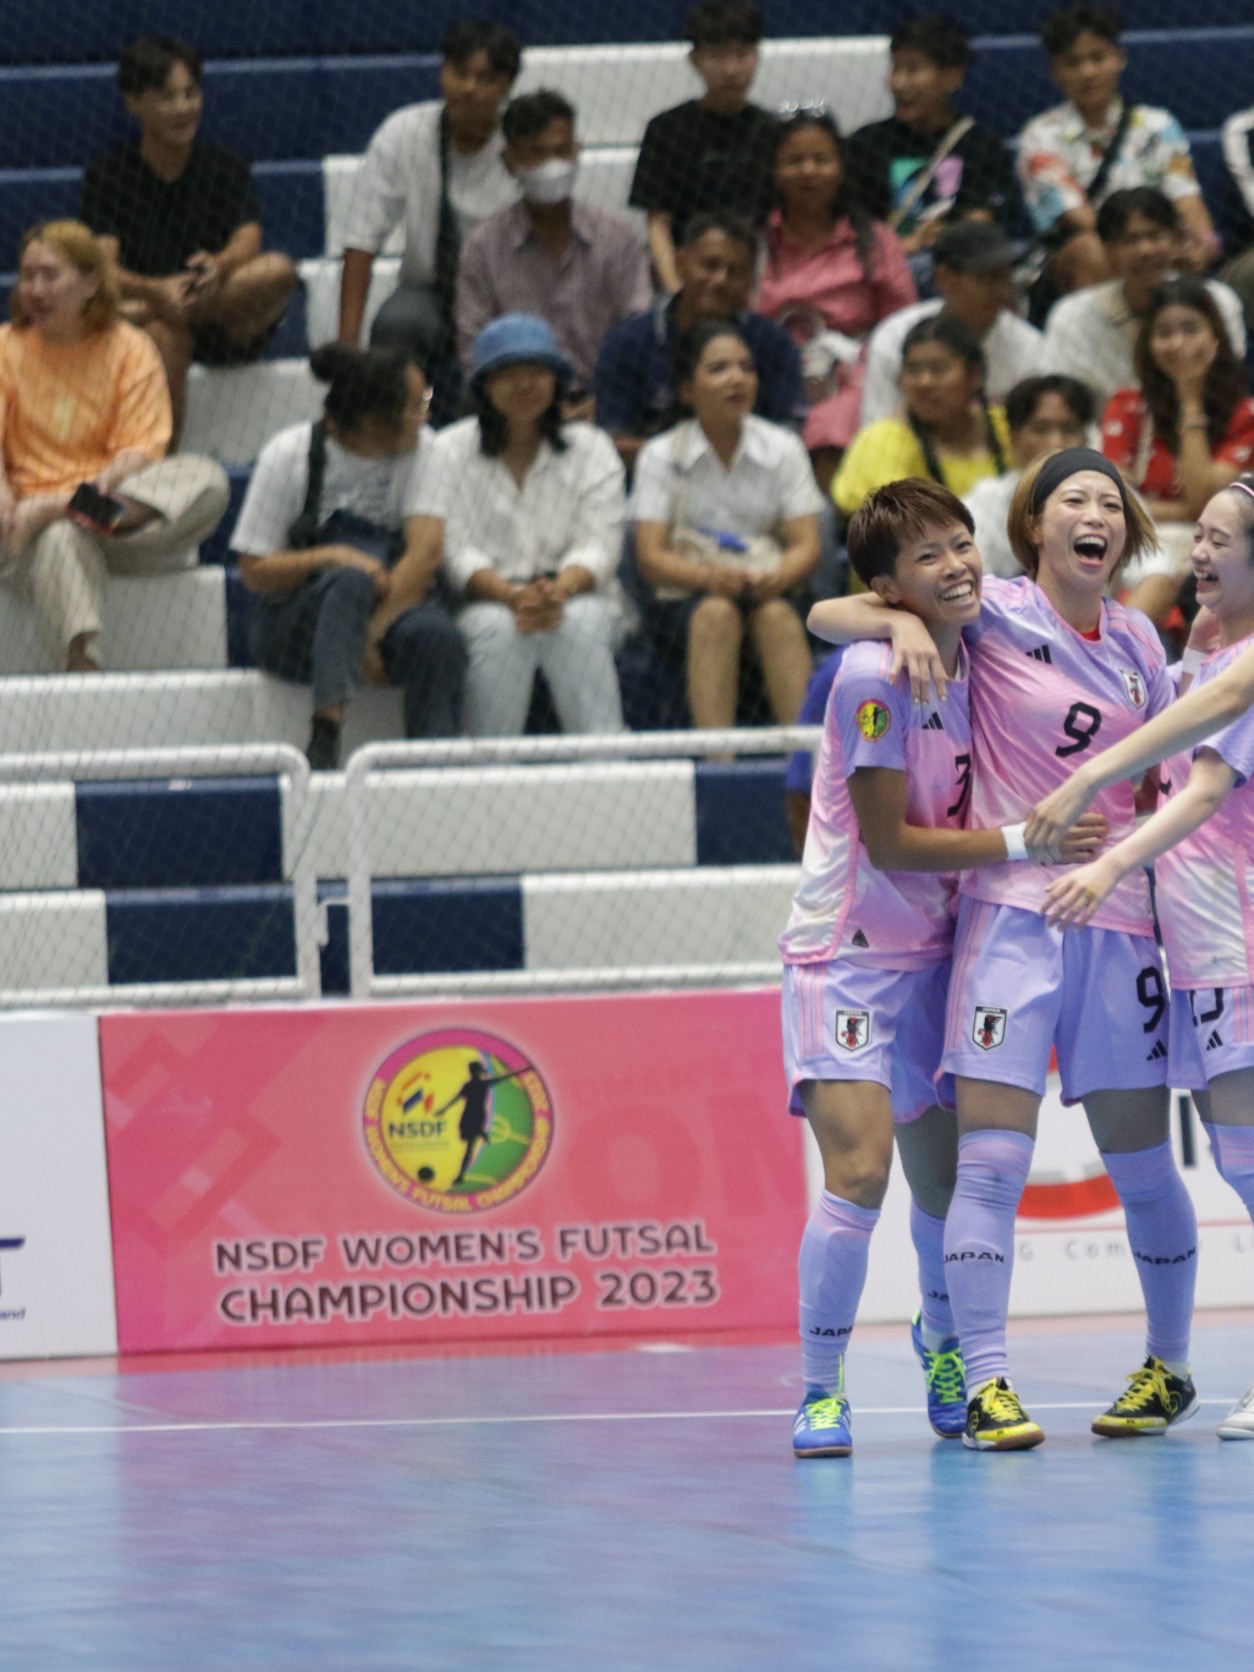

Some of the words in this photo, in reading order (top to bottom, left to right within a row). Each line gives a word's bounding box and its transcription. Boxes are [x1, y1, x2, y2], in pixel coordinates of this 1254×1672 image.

[1054, 701, 1102, 758] 9
[1136, 966, 1165, 1033] 9
[388, 1120, 446, 1139] NSDF
[215, 1240, 324, 1272] NSDF
[342, 1230, 540, 1266] WOMEN'S
[559, 1223, 714, 1257] FUTSAL
[944, 1252, 1004, 1263] JAPAN
[221, 1276, 576, 1321] CHAMPIONSHIP
[600, 1270, 717, 1307] 2023
